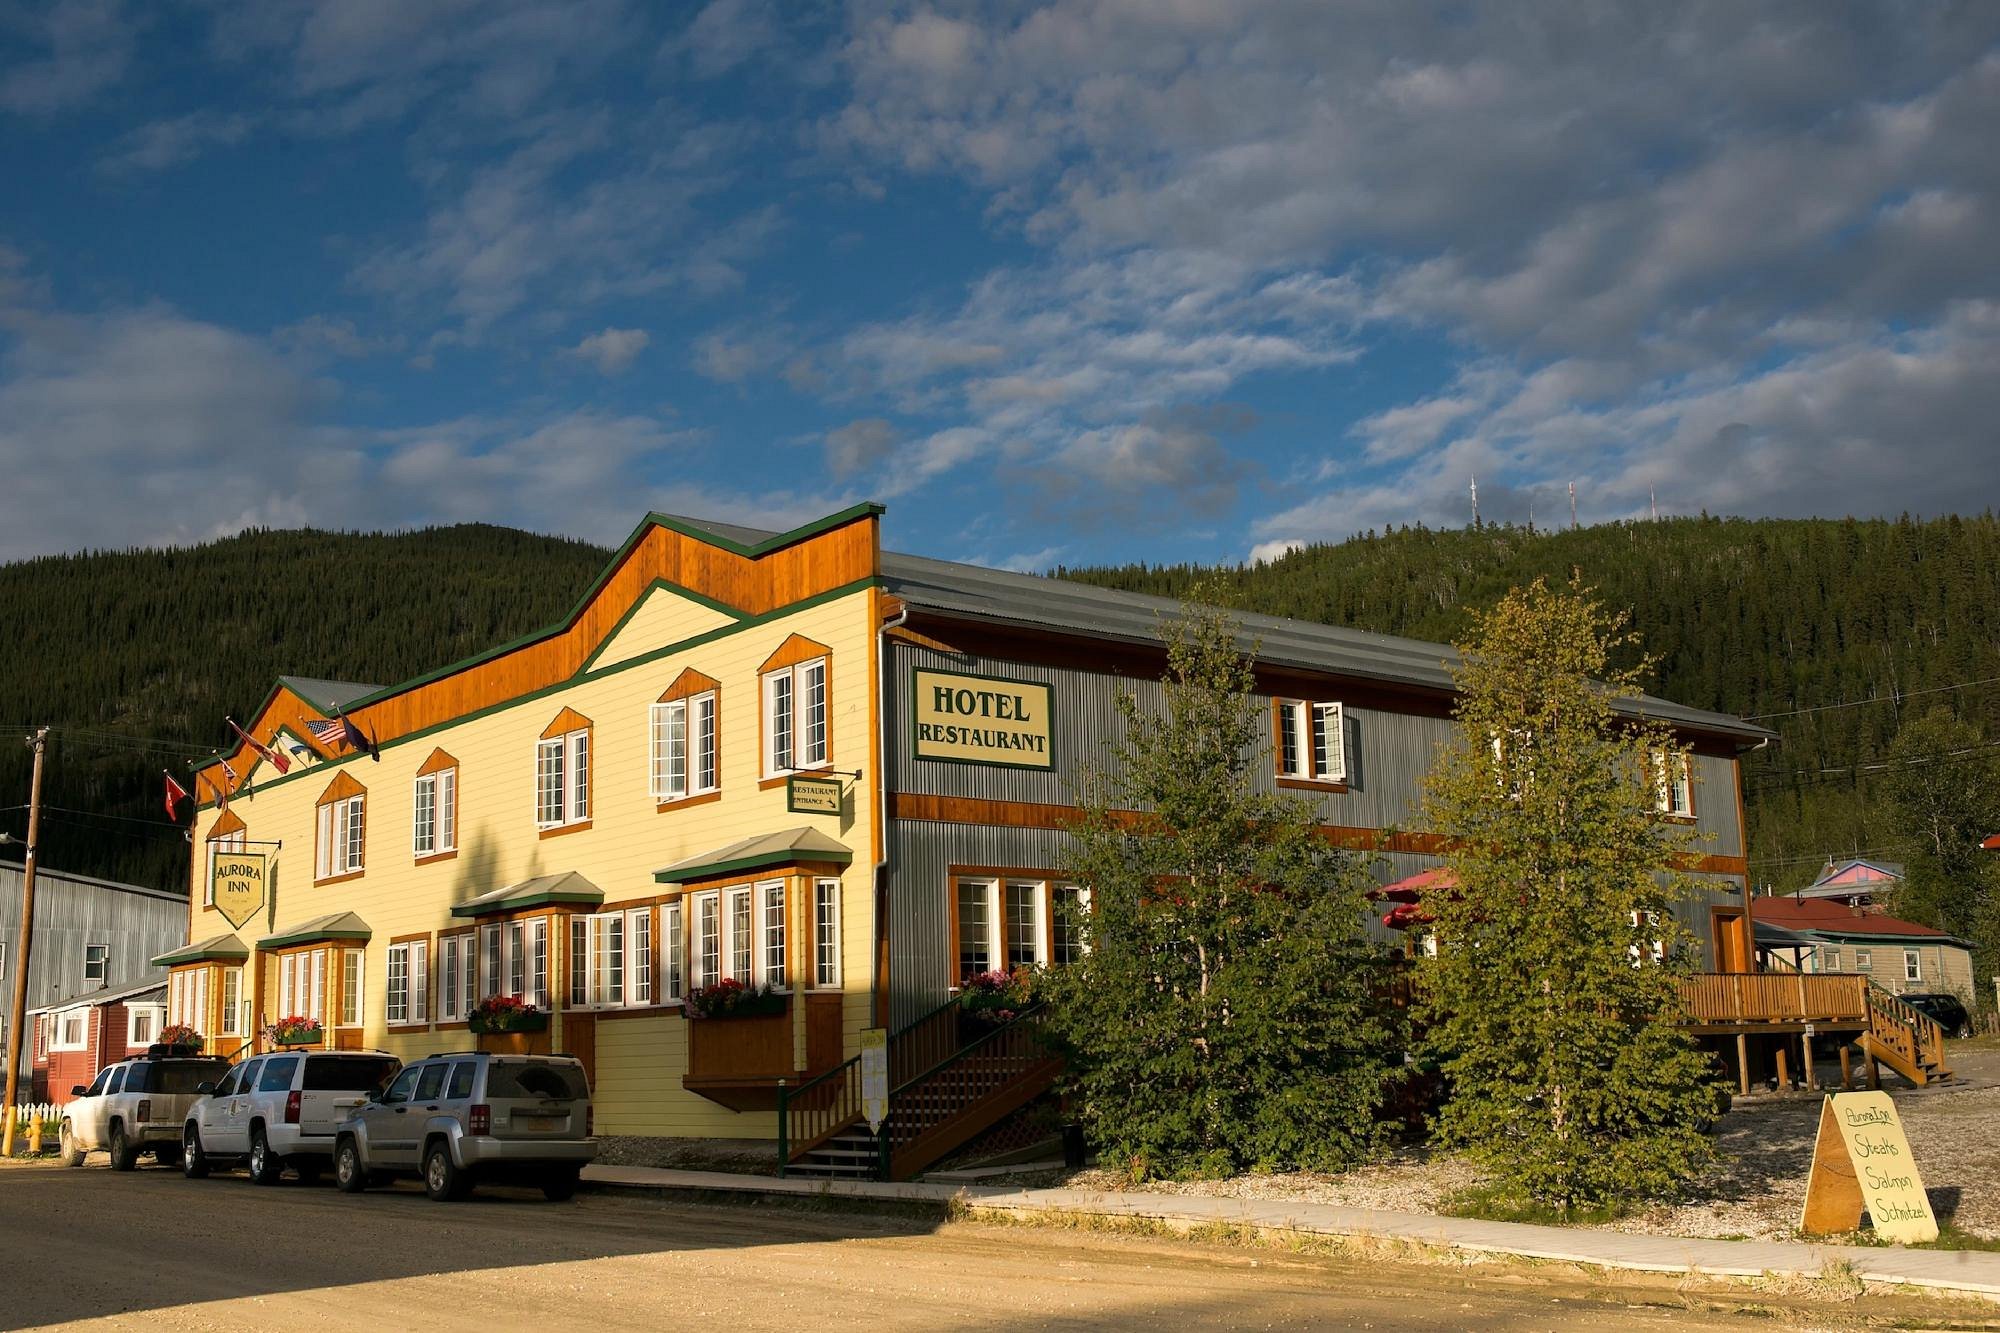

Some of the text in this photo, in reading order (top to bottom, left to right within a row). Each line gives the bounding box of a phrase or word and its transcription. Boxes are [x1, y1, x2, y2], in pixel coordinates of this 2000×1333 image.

[933, 685, 1030, 722] HOTEL
[919, 723, 1045, 752] RESTAURANT
[792, 786, 837, 795] RESTAURANT
[216, 864, 261, 880] AURORA
[227, 881, 250, 892] INN
[1854, 1133, 1899, 1158] Steaks
[1864, 1166, 1913, 1191] Salmon
[1875, 1198, 1928, 1223] Schnitzel
